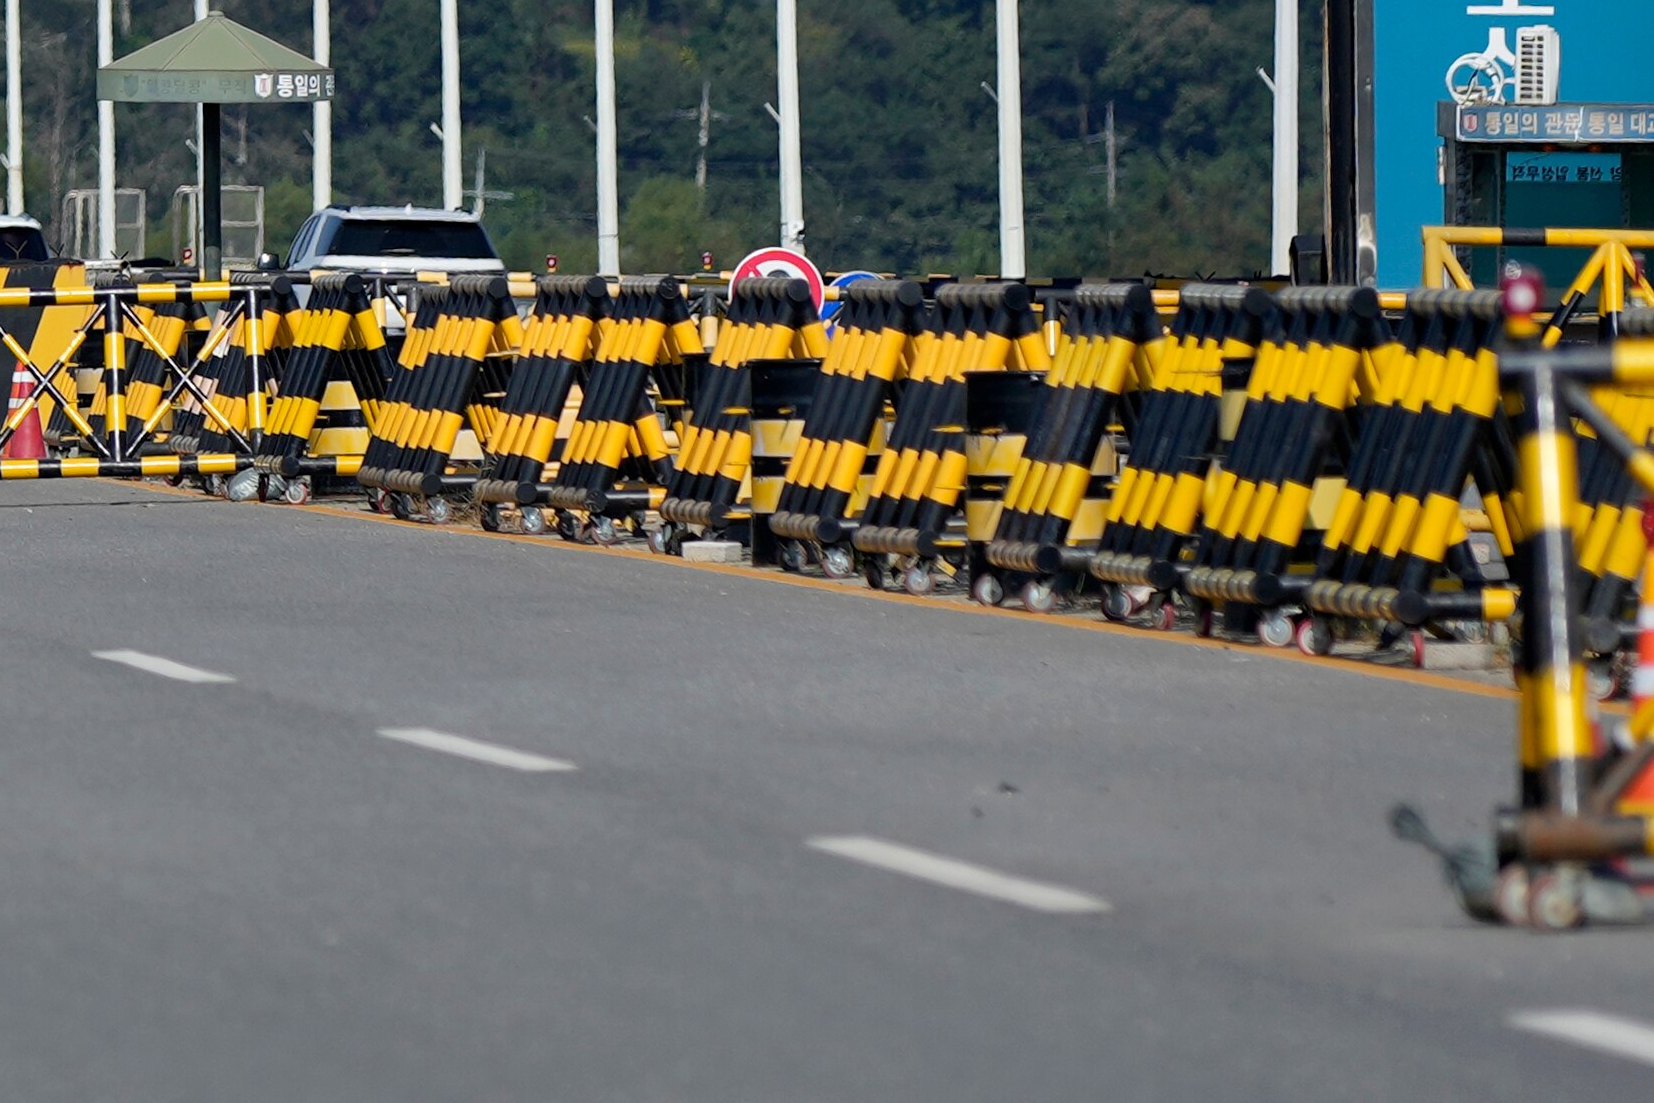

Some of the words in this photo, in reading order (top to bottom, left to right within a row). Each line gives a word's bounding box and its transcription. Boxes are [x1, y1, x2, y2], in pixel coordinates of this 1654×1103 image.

[277, 74, 321, 98] 통일의
[1485, 111, 1538, 135] 통일의
[1545, 111, 1582, 135] 관문
[1588, 111, 1625, 135] 통일
